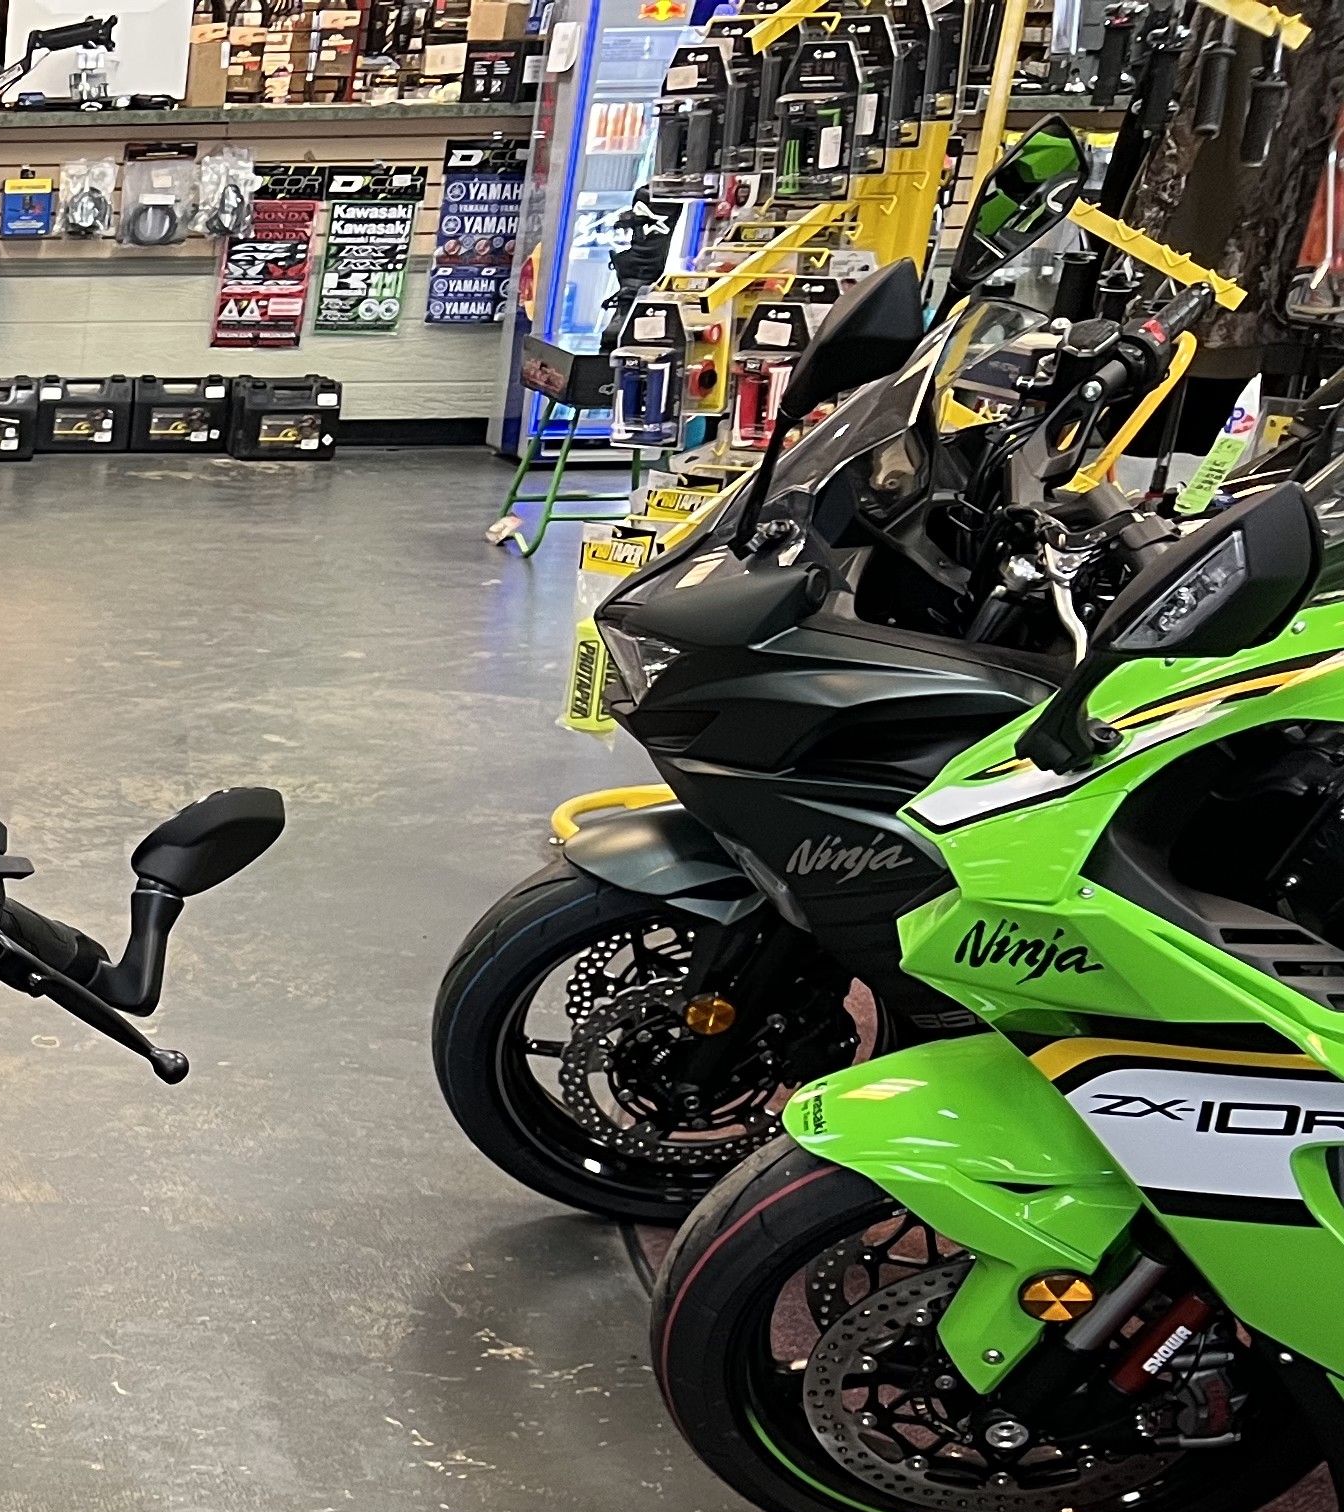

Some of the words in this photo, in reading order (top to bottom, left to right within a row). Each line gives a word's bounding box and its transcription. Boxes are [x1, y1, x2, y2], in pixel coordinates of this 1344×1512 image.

[469, 182, 523, 201] YAMAH
[333, 204, 413, 219] Kawasaki
[331, 220, 411, 238] Kawasaki
[463, 216, 519, 234] YAMAH
[448, 278, 496, 293] YAMAHA
[443, 301, 492, 315] YAMAHA
[572, 642, 598, 718] PROTAPER
[786, 834, 915, 884] Ninja
[955, 919, 1104, 984] Ninja
[910, 1010, 989, 1029] 65
[1142, 1325, 1193, 1375] SHOWA
